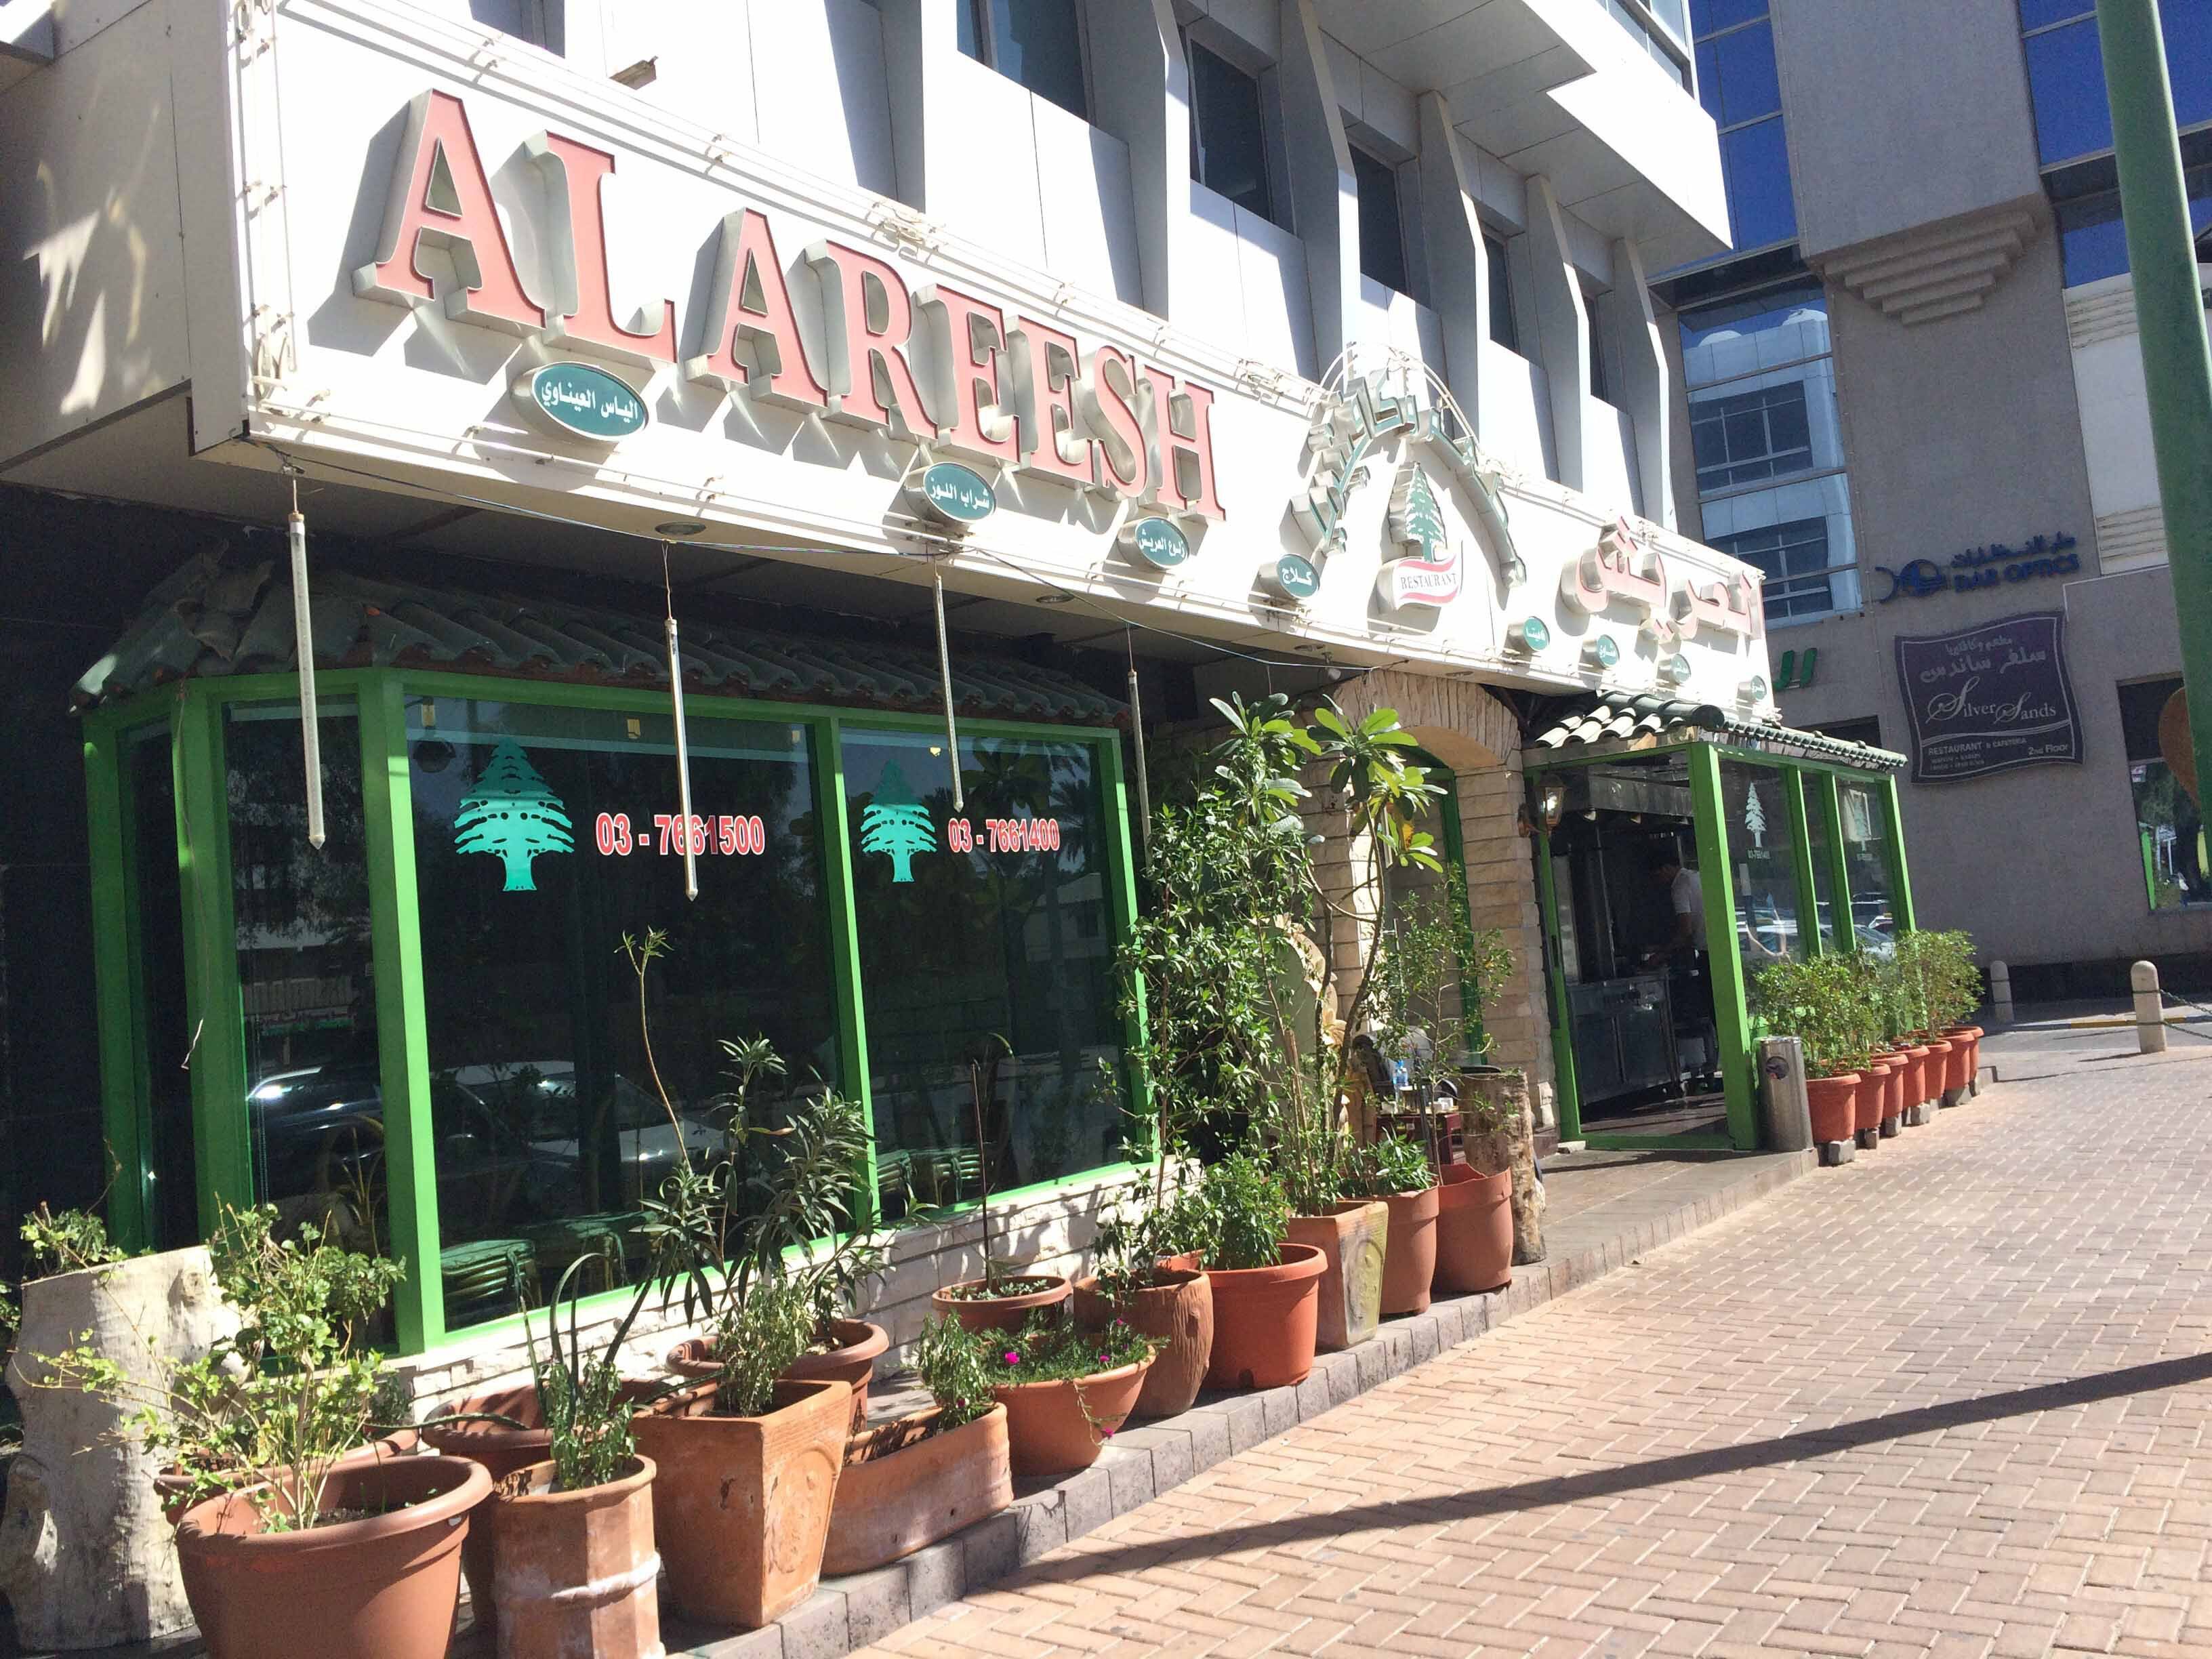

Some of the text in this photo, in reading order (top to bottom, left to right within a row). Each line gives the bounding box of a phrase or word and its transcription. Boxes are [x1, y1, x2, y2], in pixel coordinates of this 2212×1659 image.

[960, 488, 990, 510] شراب
[1400, 573, 1457, 590] RESTAURANT
[2003, 553, 2080, 583] OPTICS
[1925, 676, 2056, 724] Silver Sands
[1928, 741, 1983, 756] RESTAURANT
[596, 812, 633, 856] 03
[653, 813, 766, 856] 7661500
[948, 817, 973, 853] 03
[985, 819, 1060, 853] 7661400
